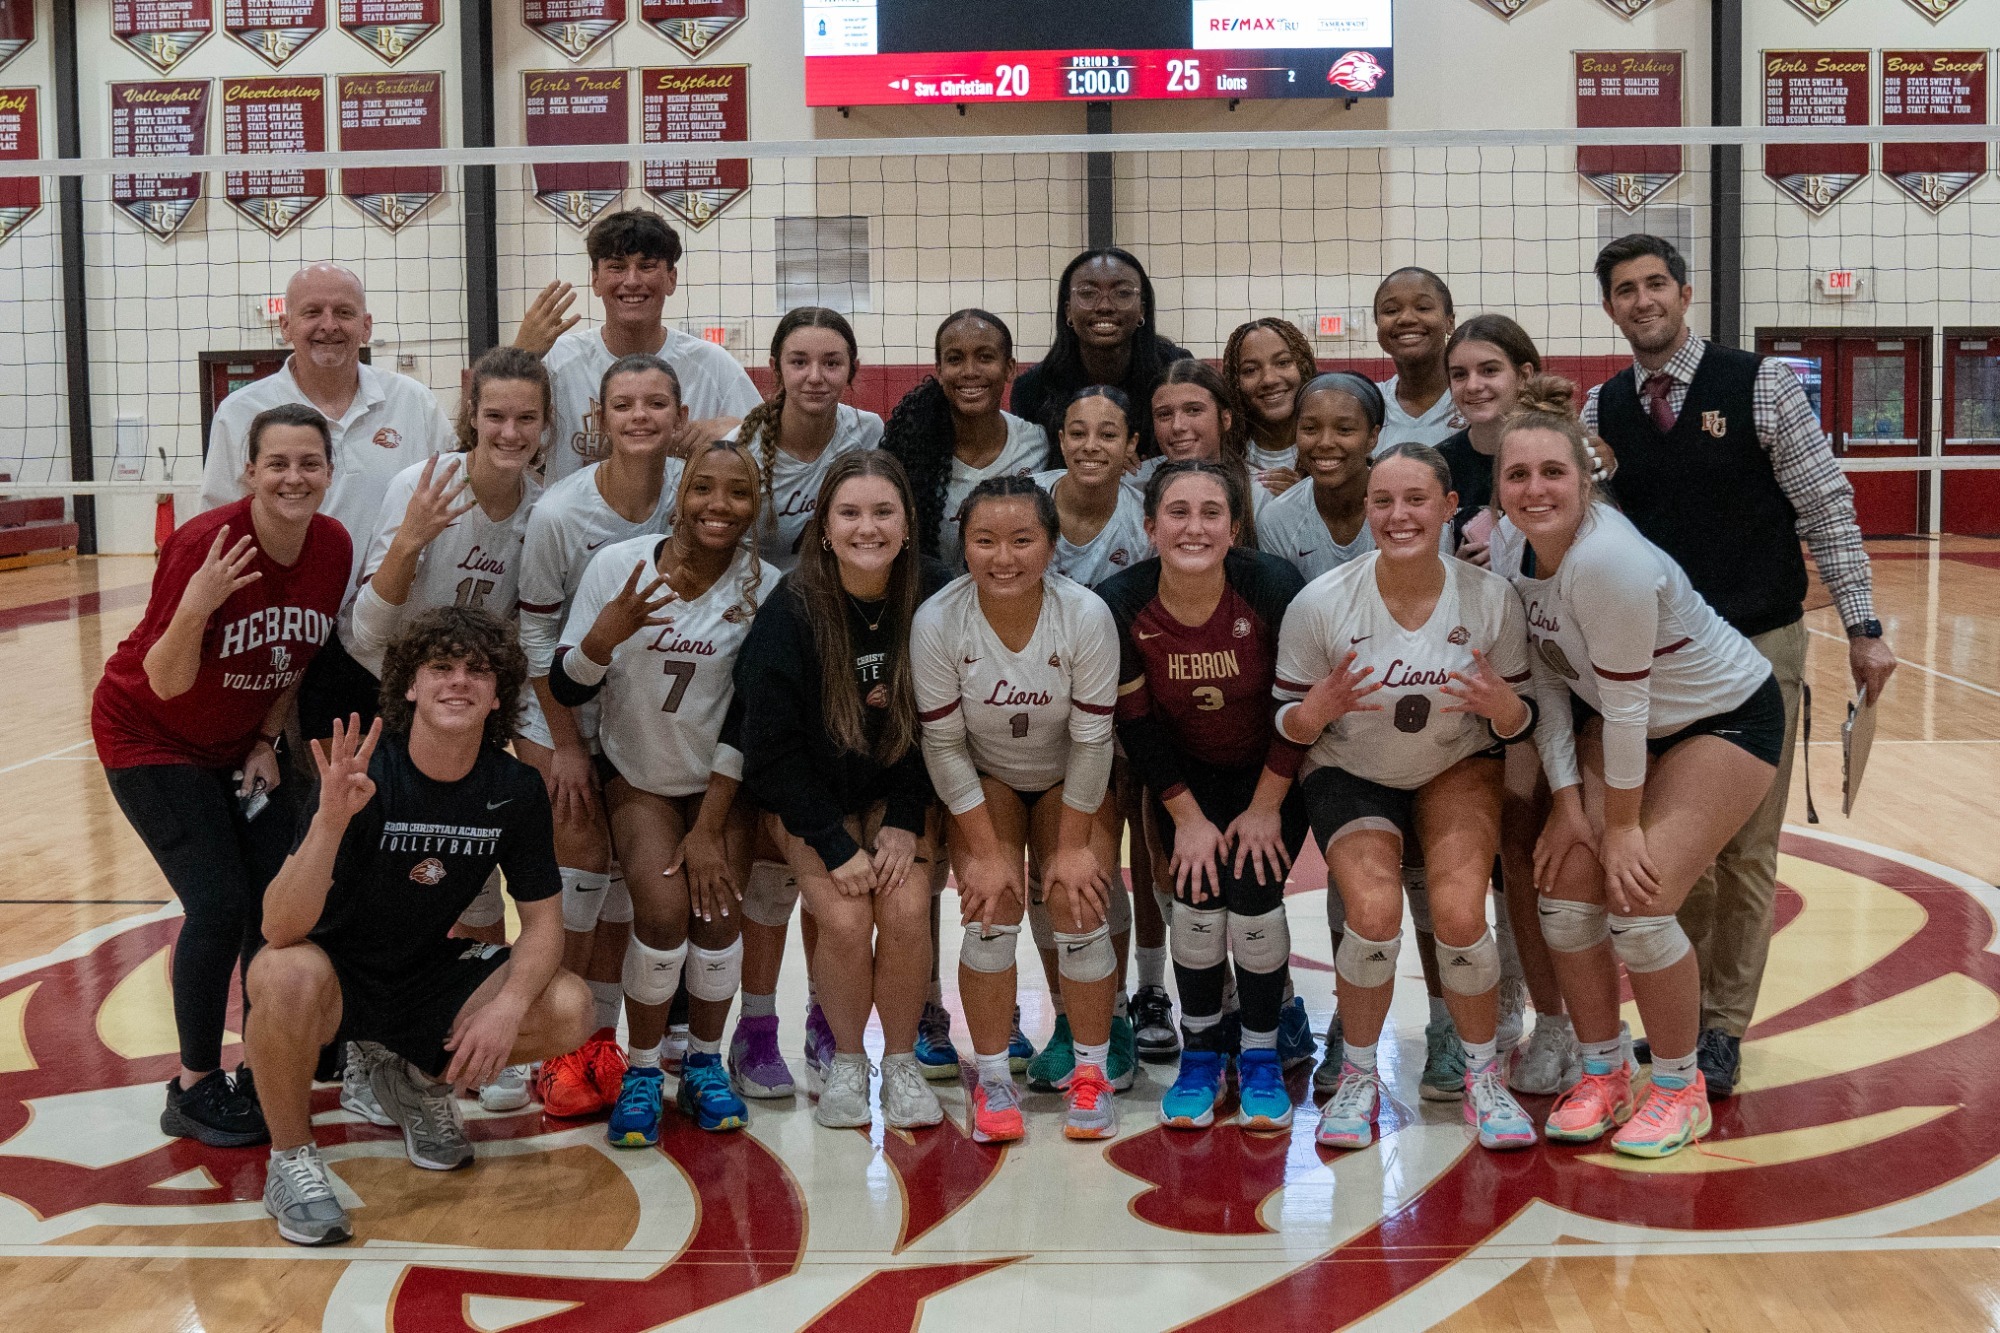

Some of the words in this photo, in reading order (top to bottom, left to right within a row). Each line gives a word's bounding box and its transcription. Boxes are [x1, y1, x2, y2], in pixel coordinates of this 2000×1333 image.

[136, 3, 155, 11] STATE
[157, 2, 192, 10] CHAMPIONS
[269, 8, 312, 16] TOURNAMENT
[386, 3, 423, 11] CHAMPIONS
[547, 10, 567, 18] STATE
[582, 8, 602, 16] PLACE
[115, 13, 130, 21] 2015
[136, 12, 157, 20] STATE
[271, 17, 291, 25] SWEET
[386, 12, 422, 20] CHAMPIONS
[1210, 18, 1274, 31] RE/MAX
[1072, 57, 1108, 67] PERIOD
[1112, 56, 1119, 66] 3
[1582, 59, 1617, 72] Bass
[1621, 58, 1675, 75] Fishing
[1768, 59, 1808, 76] Girls
[1815, 58, 1866, 72] Soccer
[1887, 58, 1925, 74] Boys
[1932, 58, 1984, 72] Soccer
[996, 65, 1029, 96] 20
[1067, 70, 1129, 94] 1:00.0
[1166, 60, 1200, 91] 25
[1288, 70, 1295, 82] 2
[1601, 78, 1620, 86] STATE
[1624, 78, 1659, 86] QUALIFIER
[530, 78, 571, 96] Girls
[576, 77, 621, 90] Track
[657, 75, 732, 92] Softball
[915, 82, 939, 96] Sav.
[941, 80, 993, 96] Christian
[1217, 75, 1247, 90] Lions
[123, 88, 201, 104] Volleyball
[225, 85, 321, 102] Cheerleading
[345, 82, 372, 99] Girls
[376, 80, 435, 94] Basketball
[1579, 88, 1596, 96] 2022
[1767, 88, 1782, 96] 2017
[1885, 87, 1900, 95] 2017
[363, 100, 382, 108] STATE
[386, 99, 424, 107] RUNNER-UP
[571, 96, 608, 104] CHAMPIONS
[1790, 97, 1807, 105] AREA
[1810, 97, 1846, 105] CHAMPIONS
[1907, 96, 1928, 104] STATE
[1931, 96, 1953, 104] SWEET
[1955, 96, 1961, 104] 16
[154, 107, 190, 115] CHAMPIONS
[268, 104, 280, 112] 4TH
[342, 110, 358, 118] 2023
[390, 108, 427, 116] CHAMPIONS
[528, 107, 544, 115] 2023
[550, 106, 569, 114] STATE
[572, 105, 606, 113] QUALIFIER
[667, 104, 689, 112] SWEET
[1790, 106, 1812, 114] STATE
[1814, 106, 1836, 114] SWEET
[1838, 106, 1844, 114] 16
[270, 122, 282, 130] 4TH
[342, 120, 358, 128] 2023
[362, 118, 380, 126] STATE
[384, 118, 421, 126] CHAMPIONS
[135, 126, 153, 134] AREA
[1830, 272, 1851, 288] EXIT
[1320, 317, 1341, 332] EXIT
[704, 328, 725, 344] EXIT
[779, 490, 816, 516] Lio
[220, 606, 334, 658] HEBRON
[646, 627, 717, 656] Lions
[857, 653, 886, 666] CHRIST
[1168, 650, 1240, 680] HEBRON
[222, 668, 304, 690] VOLLEYBA
[1380, 659, 1450, 688] Lions
[661, 660, 696, 714] 7
[984, 680, 1053, 706] Lions
[1192, 686, 1225, 710] 3
[1394, 694, 1431, 734] 8
[1009, 712, 1029, 738] 1
[410, 823, 458, 834] CHRISTIAN
[458, 826, 502, 837] ACADEMY
